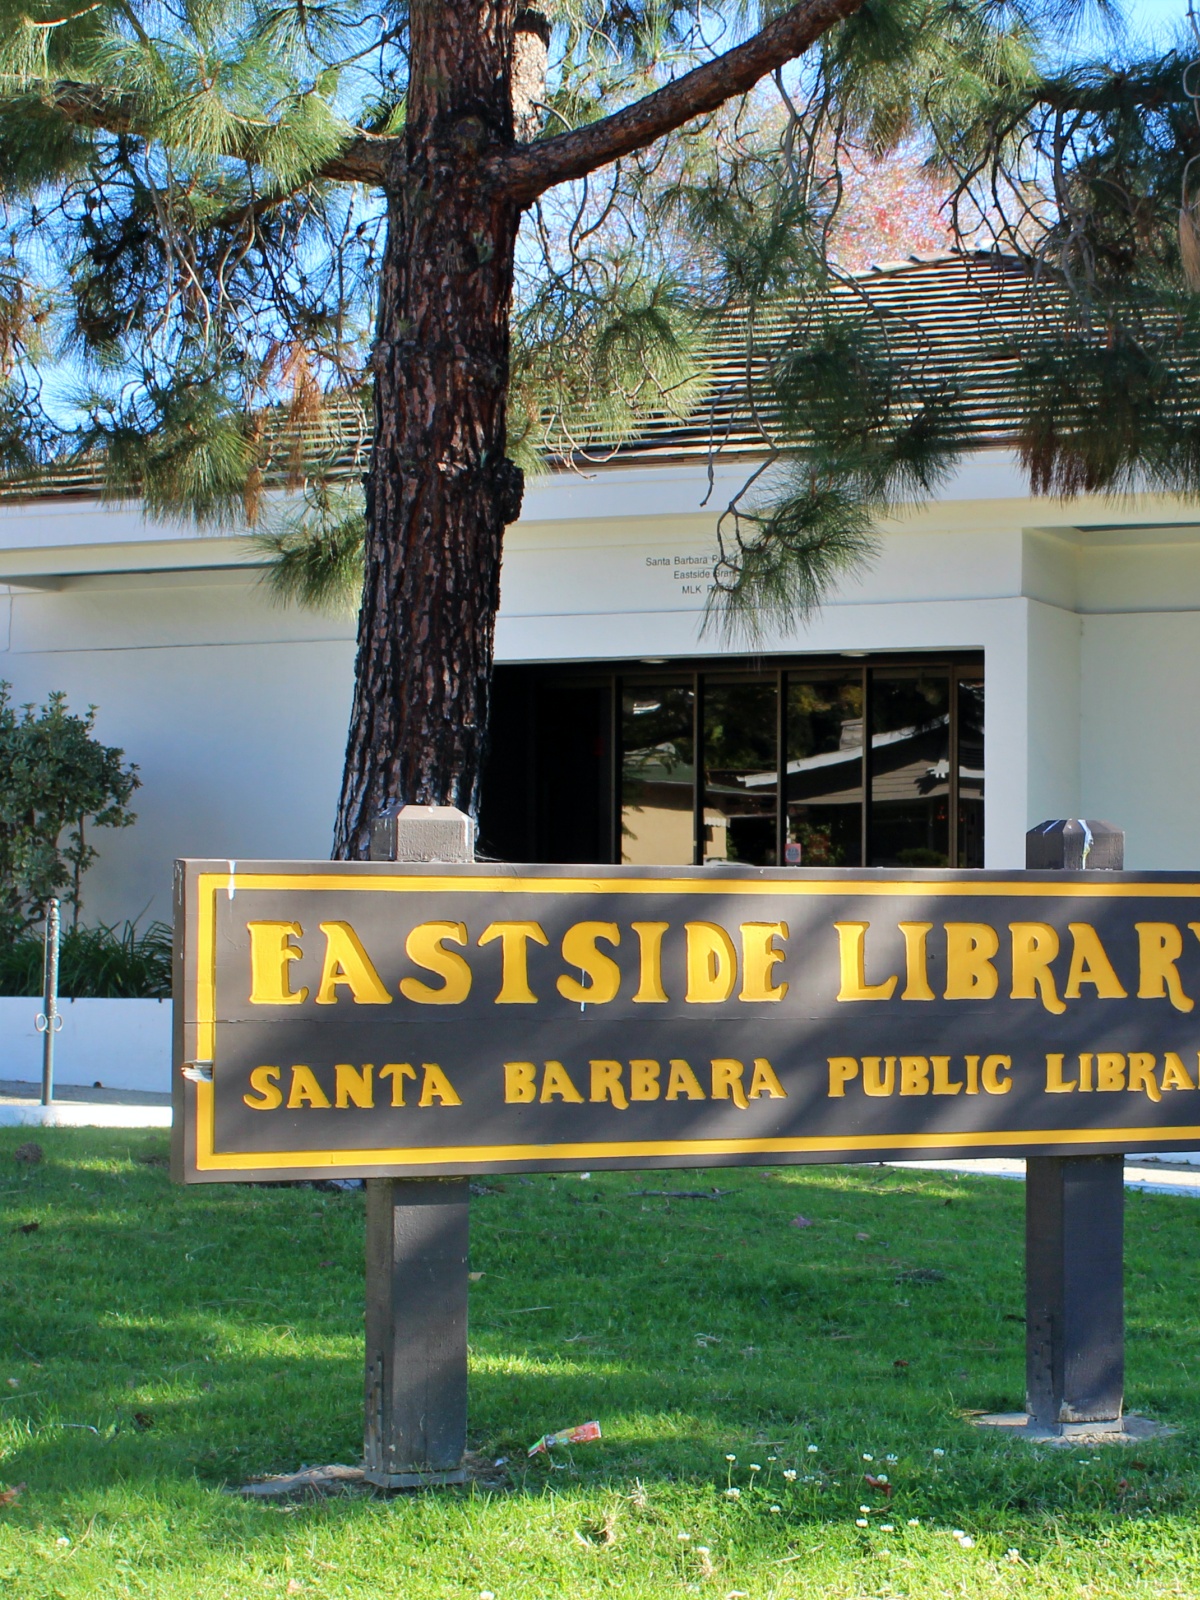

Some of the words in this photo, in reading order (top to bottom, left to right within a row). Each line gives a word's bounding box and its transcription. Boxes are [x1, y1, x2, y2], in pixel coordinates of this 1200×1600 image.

[645, 556, 671, 567] Santa
[674, 555, 708, 566] Barbara
[673, 568, 711, 579] Eastside
[681, 585, 702, 594] MLK
[246, 920, 790, 1006] EASTSIDE
[242, 1062, 464, 1111] SANTA
[503, 1057, 788, 1110] BARBARA
[826, 1053, 1014, 1097] PUBLIC
